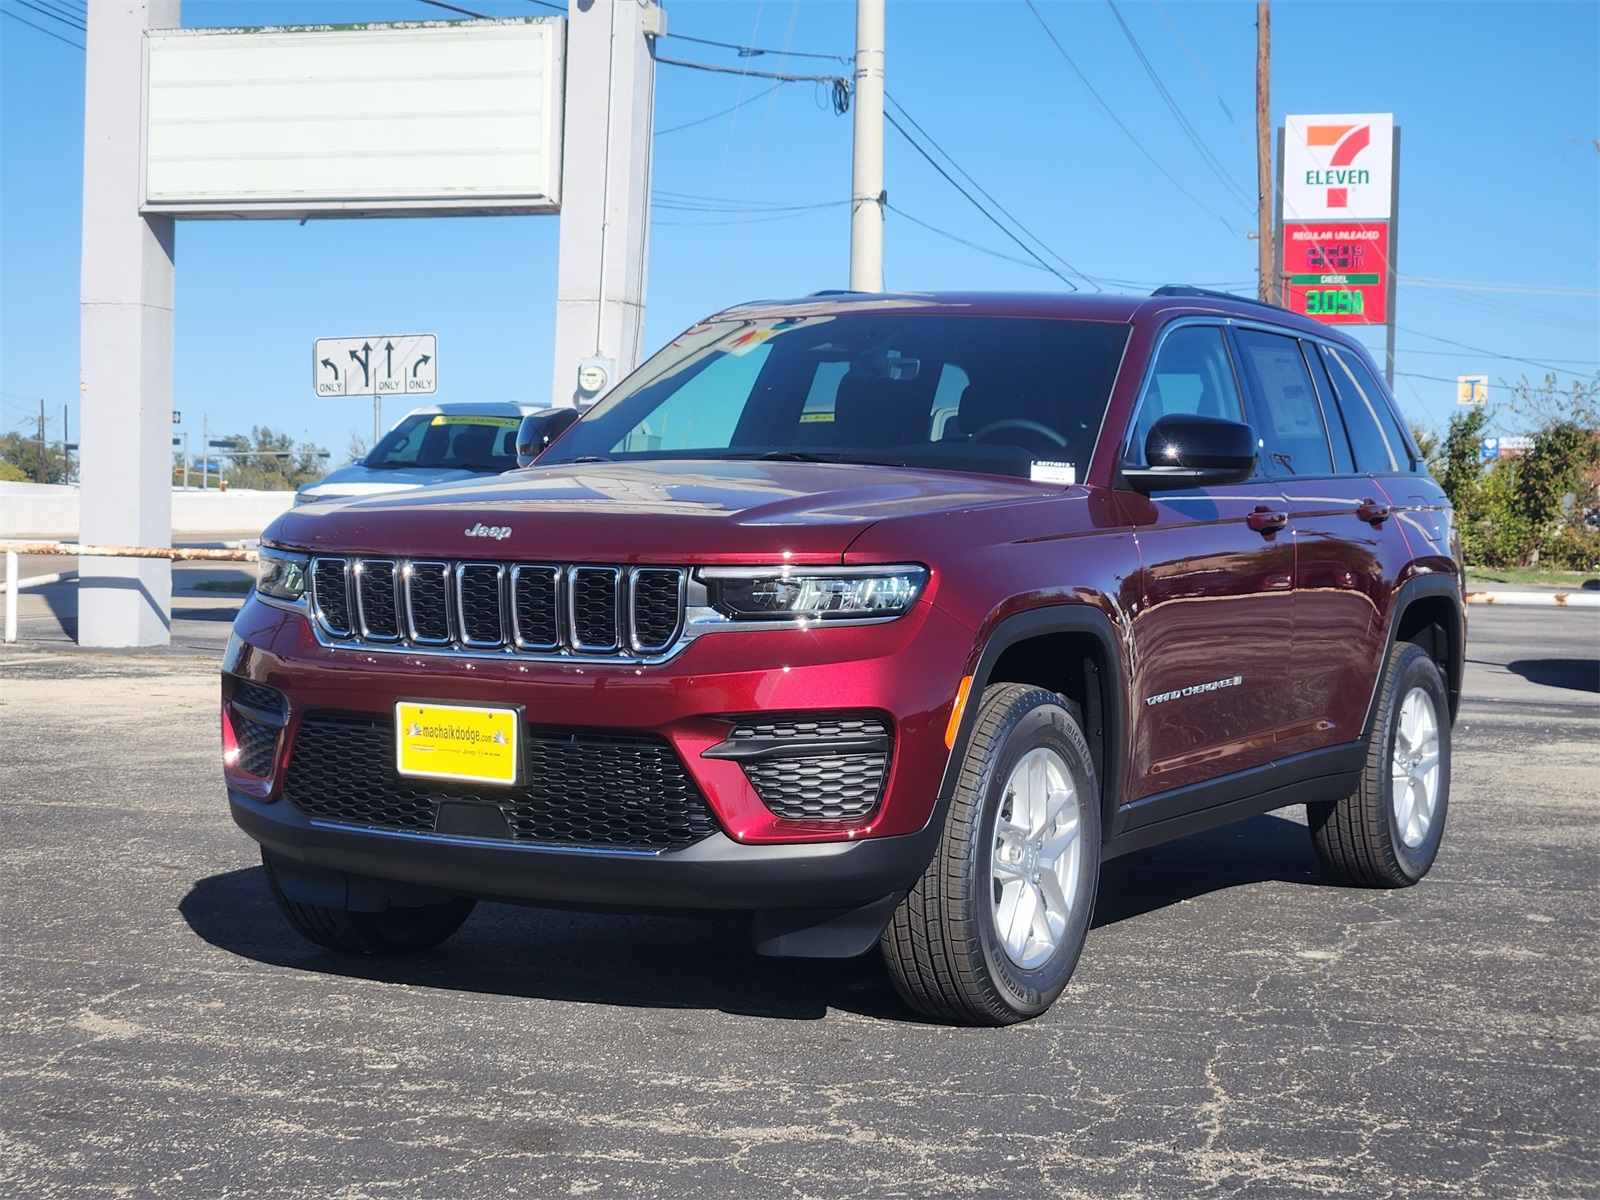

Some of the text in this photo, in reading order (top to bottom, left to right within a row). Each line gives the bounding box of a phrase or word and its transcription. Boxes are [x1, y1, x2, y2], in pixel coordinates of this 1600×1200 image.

[1292, 230, 1380, 240] REGULAR UNLEADED
[1320, 275, 1349, 284] DIESEL
[319, 383, 342, 393] ONLY
[379, 381, 400, 391] ONLY
[409, 380, 433, 390] ONLY
[464, 522, 512, 541] Jeep
[1146, 678, 1233, 705] GRAND CHEROKEE
[1064, 721, 1093, 774] MICHELIN
[993, 951, 1027, 1000] MICHELIN
